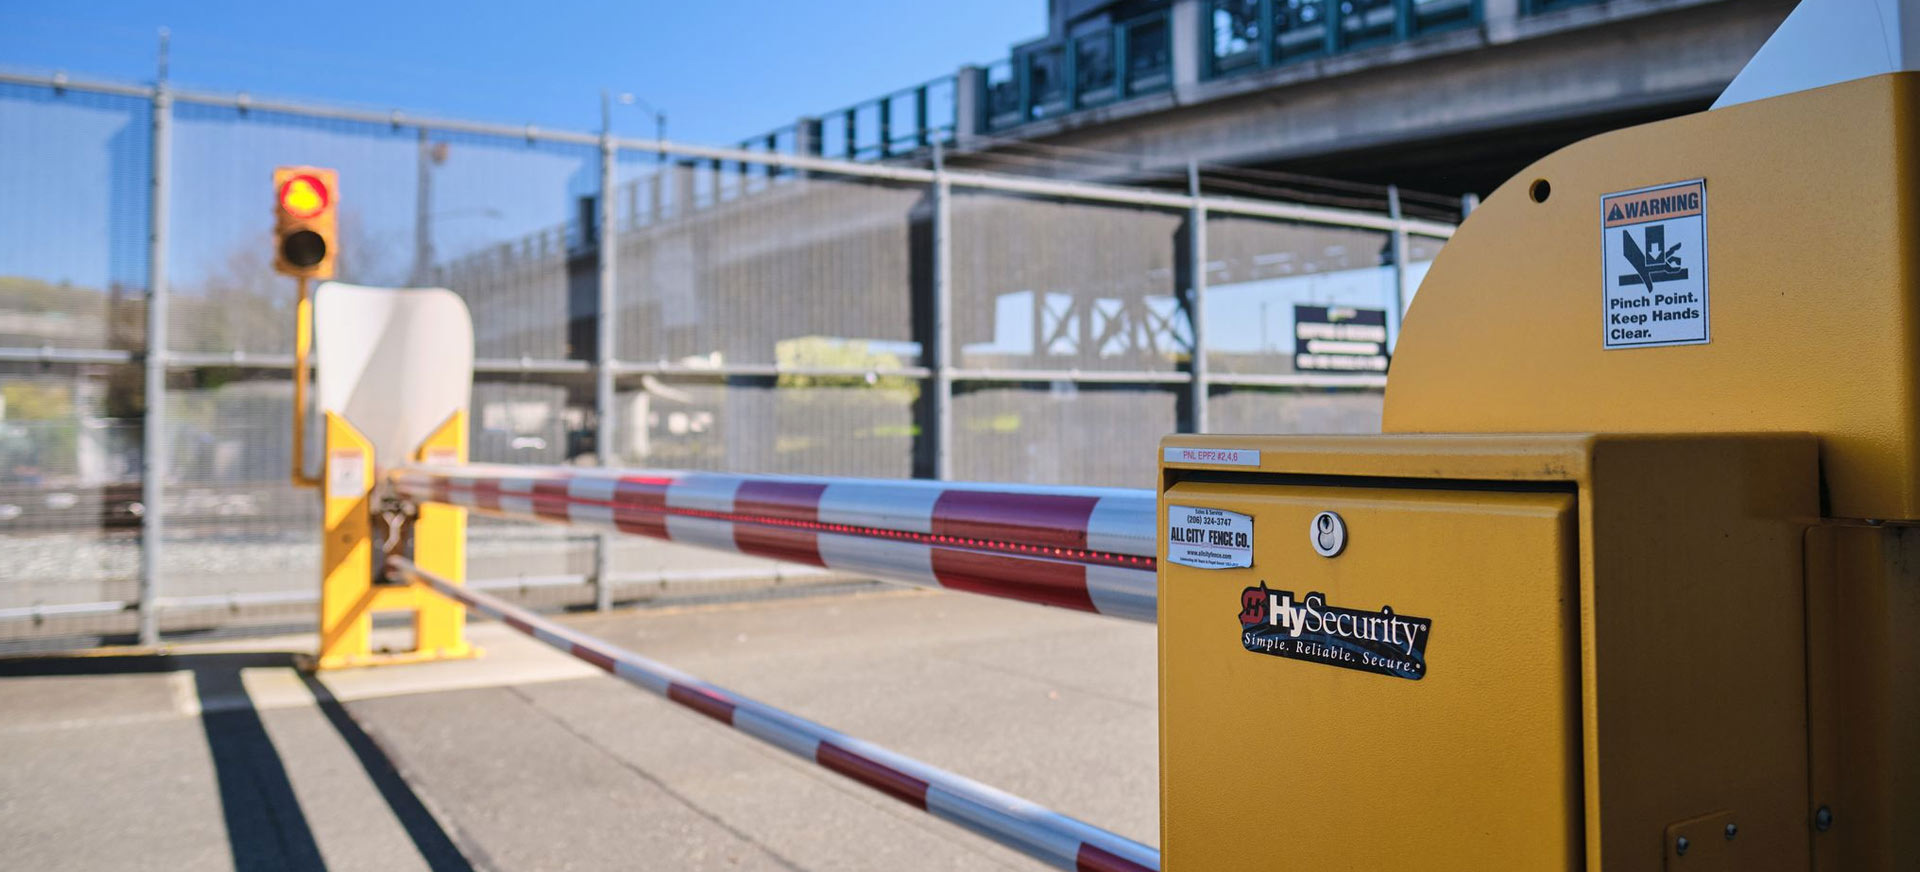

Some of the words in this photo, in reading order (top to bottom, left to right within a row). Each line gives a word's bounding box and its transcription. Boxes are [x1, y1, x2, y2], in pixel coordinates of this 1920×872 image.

[1625, 192, 1699, 219] WARNING
[1611, 296, 1650, 309] Pinch
[1655, 292, 1698, 306] Point.
[1611, 314, 1648, 326] Keep
[1653, 307, 1699, 322] Hands
[1611, 326, 1651, 340] Clear.
[1183, 450, 1196, 460] PNL
[1198, 451, 1215, 461] EPF2
[1187, 514, 1202, 525] (206)
[1203, 516, 1231, 526] 324-3747
[1171, 527, 1185, 542] ALL
[1186, 528, 1205, 543] CITY
[1208, 530, 1233, 546] FENCE
[1235, 532, 1250, 548] CO.
[1244, 632, 1290, 652] Simple.
[1296, 640, 1356, 663] Reliable.
